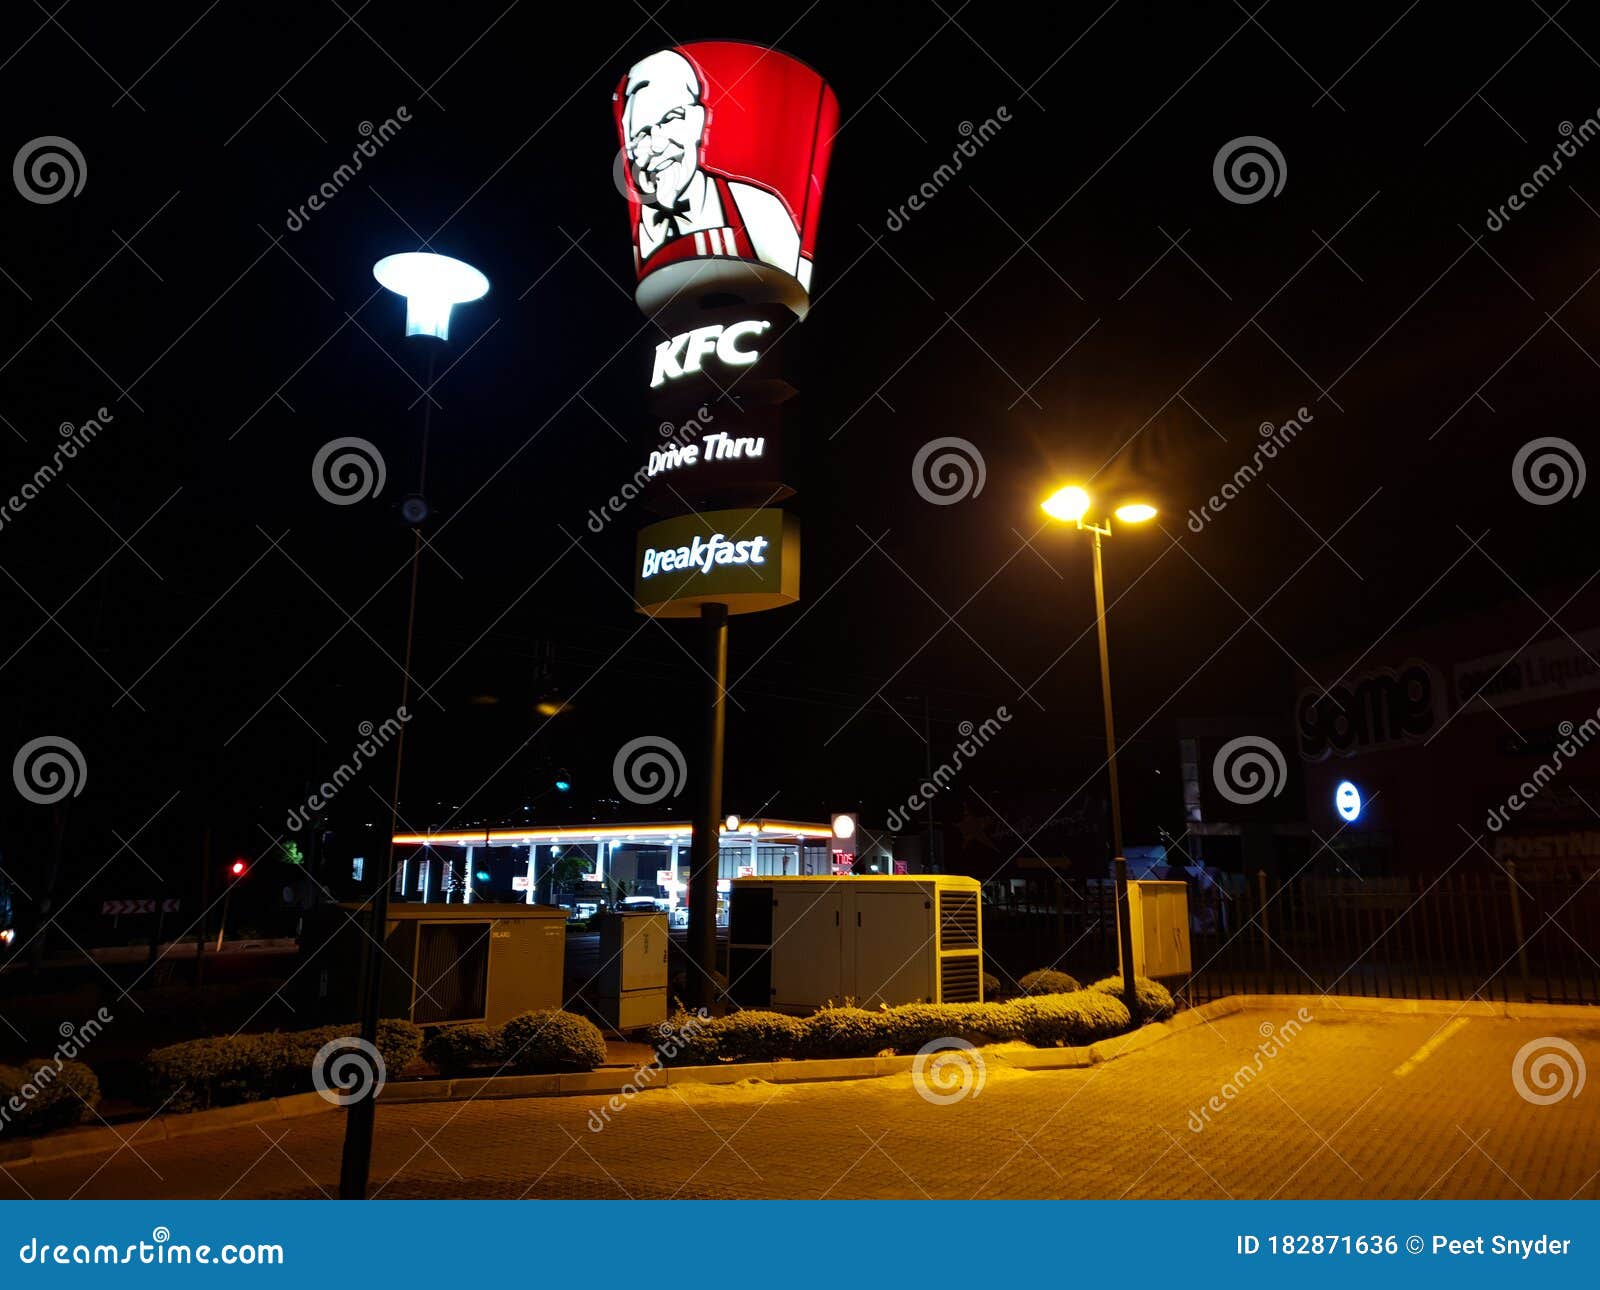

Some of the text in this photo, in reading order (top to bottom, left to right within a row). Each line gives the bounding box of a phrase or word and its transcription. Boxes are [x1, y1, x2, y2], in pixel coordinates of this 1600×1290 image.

[650, 320, 770, 388] KFC
[648, 432, 765, 477] Drive Thru
[642, 534, 768, 577] Breakfast
[1495, 831, 1600, 860] POSTN
